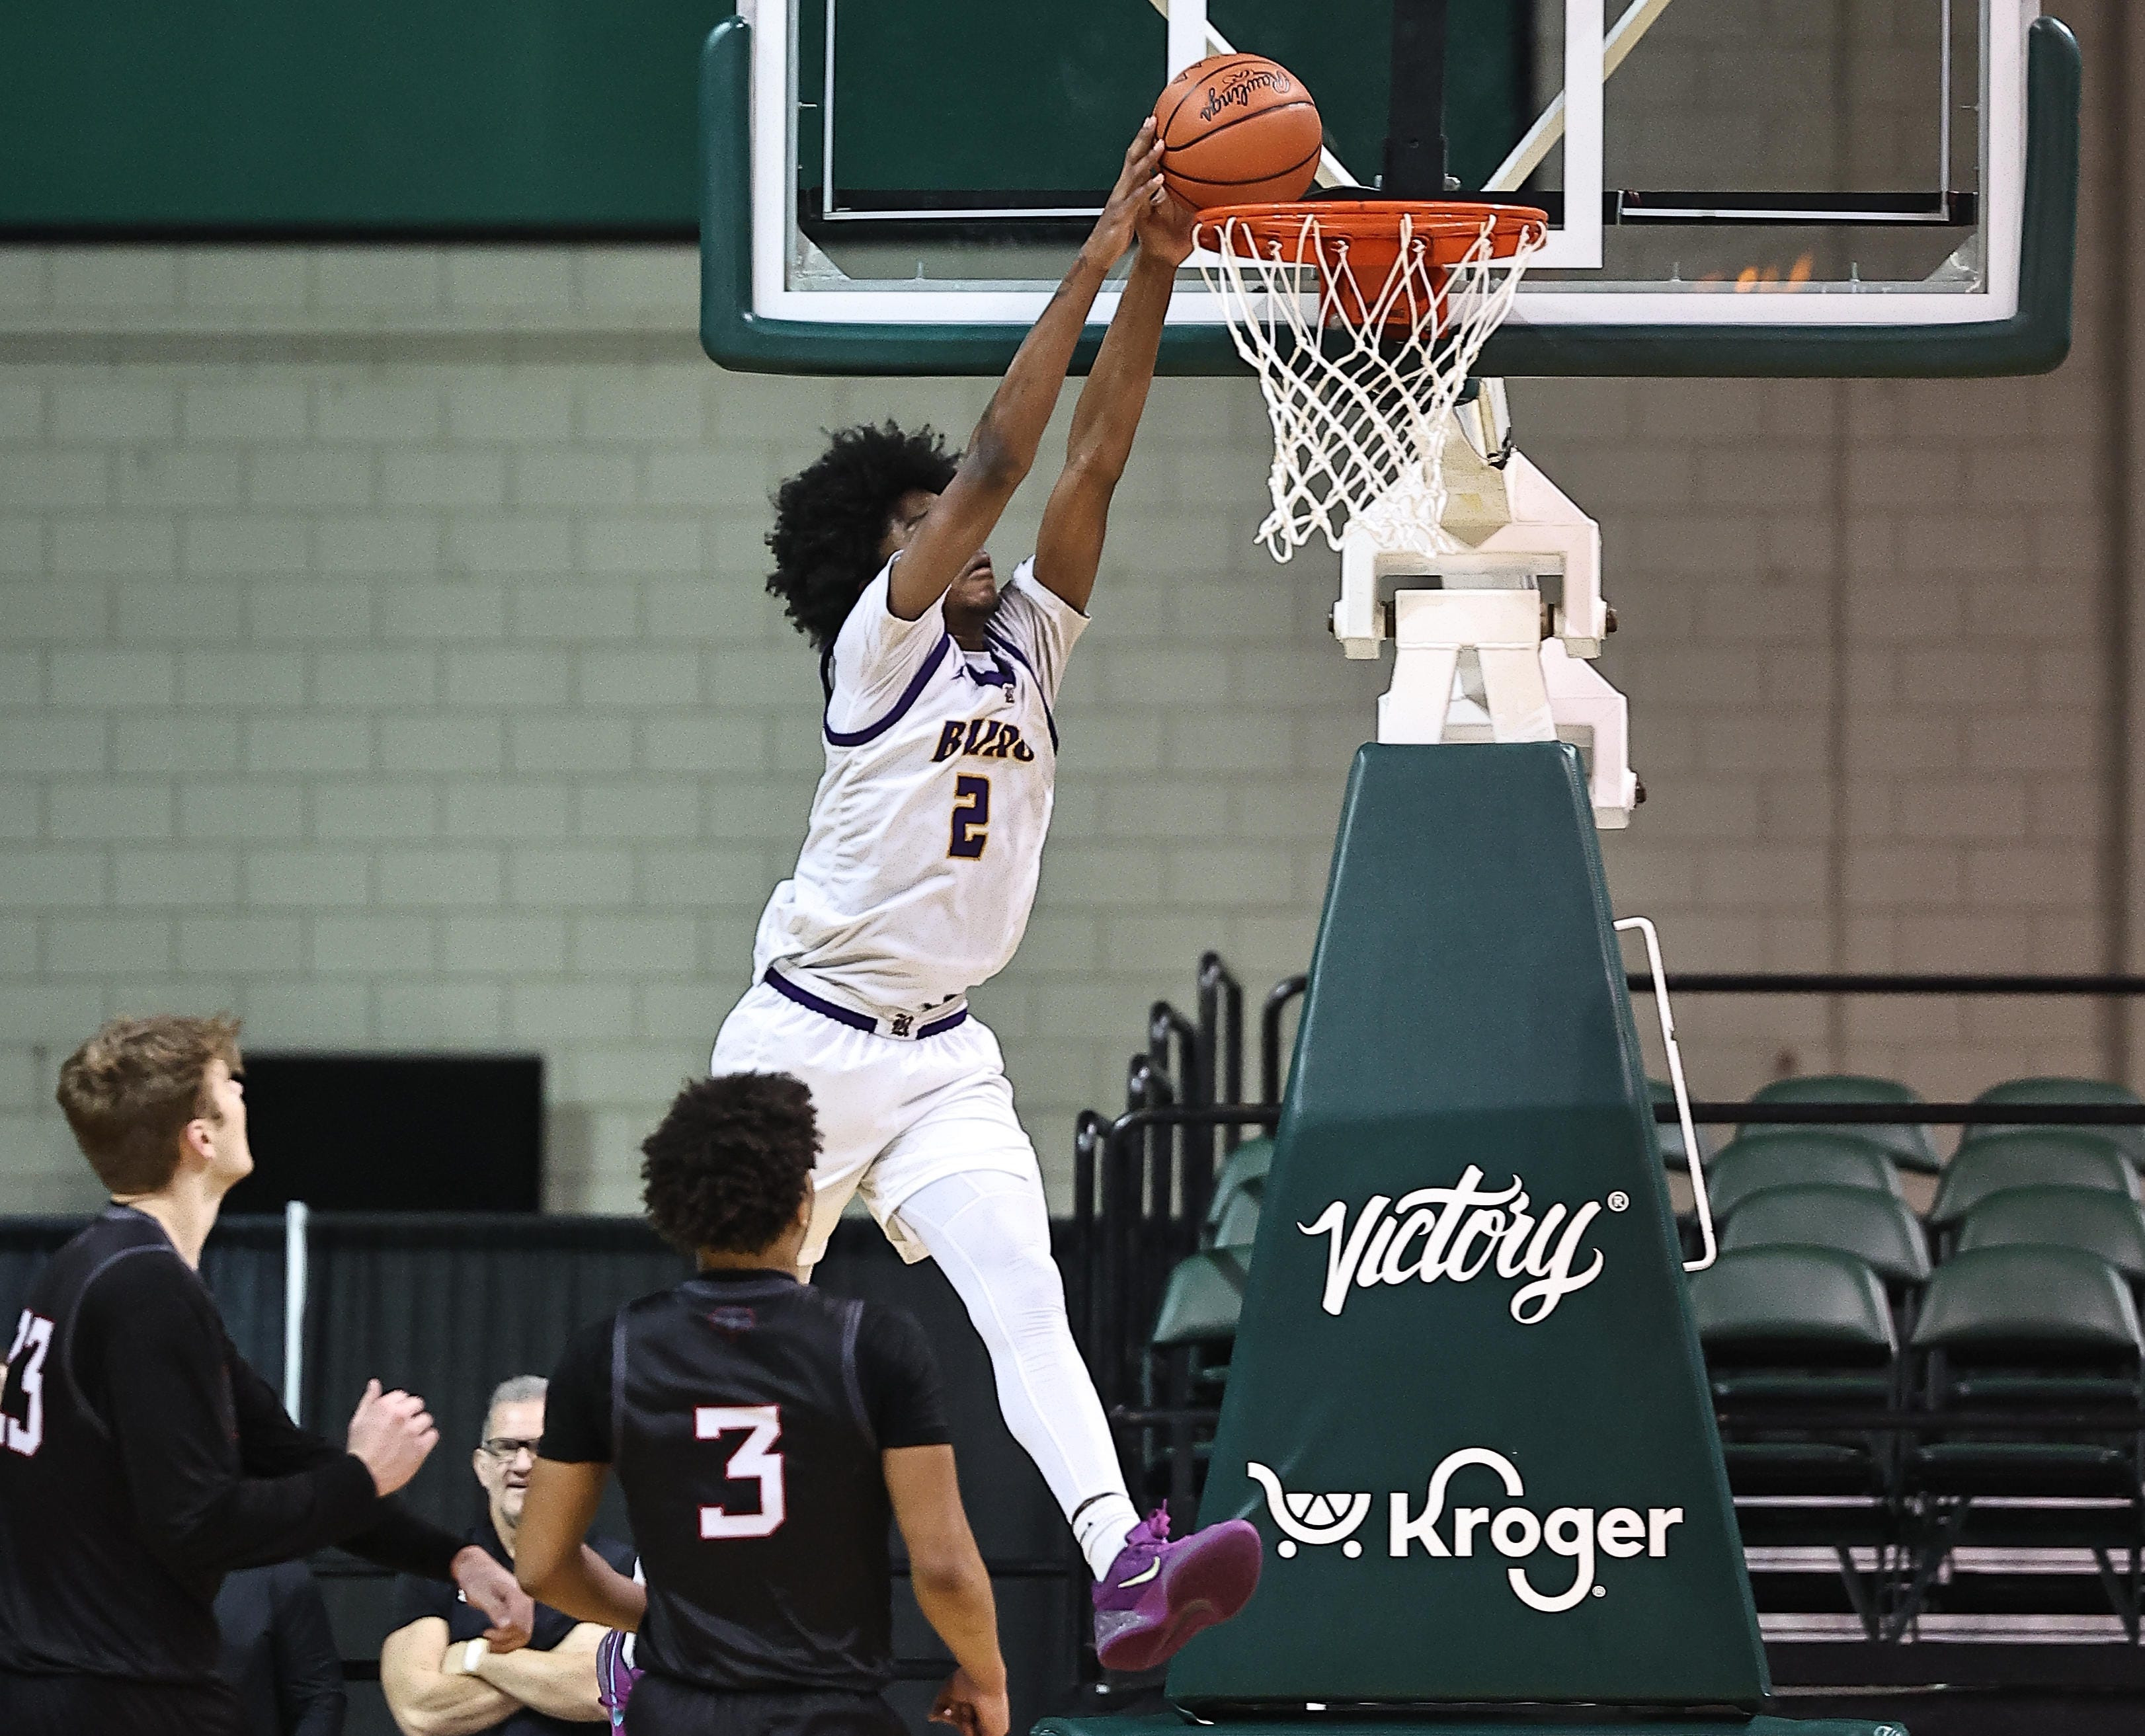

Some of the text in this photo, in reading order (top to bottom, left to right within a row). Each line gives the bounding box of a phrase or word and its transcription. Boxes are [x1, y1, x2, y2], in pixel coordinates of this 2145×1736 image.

[1200, 70, 1290, 122] Rawlings
[947, 772, 990, 861] 2
[1296, 1164, 1605, 1324] Victory
[693, 1403, 786, 1540] 3
[1389, 1447, 1684, 1612] Kroger
